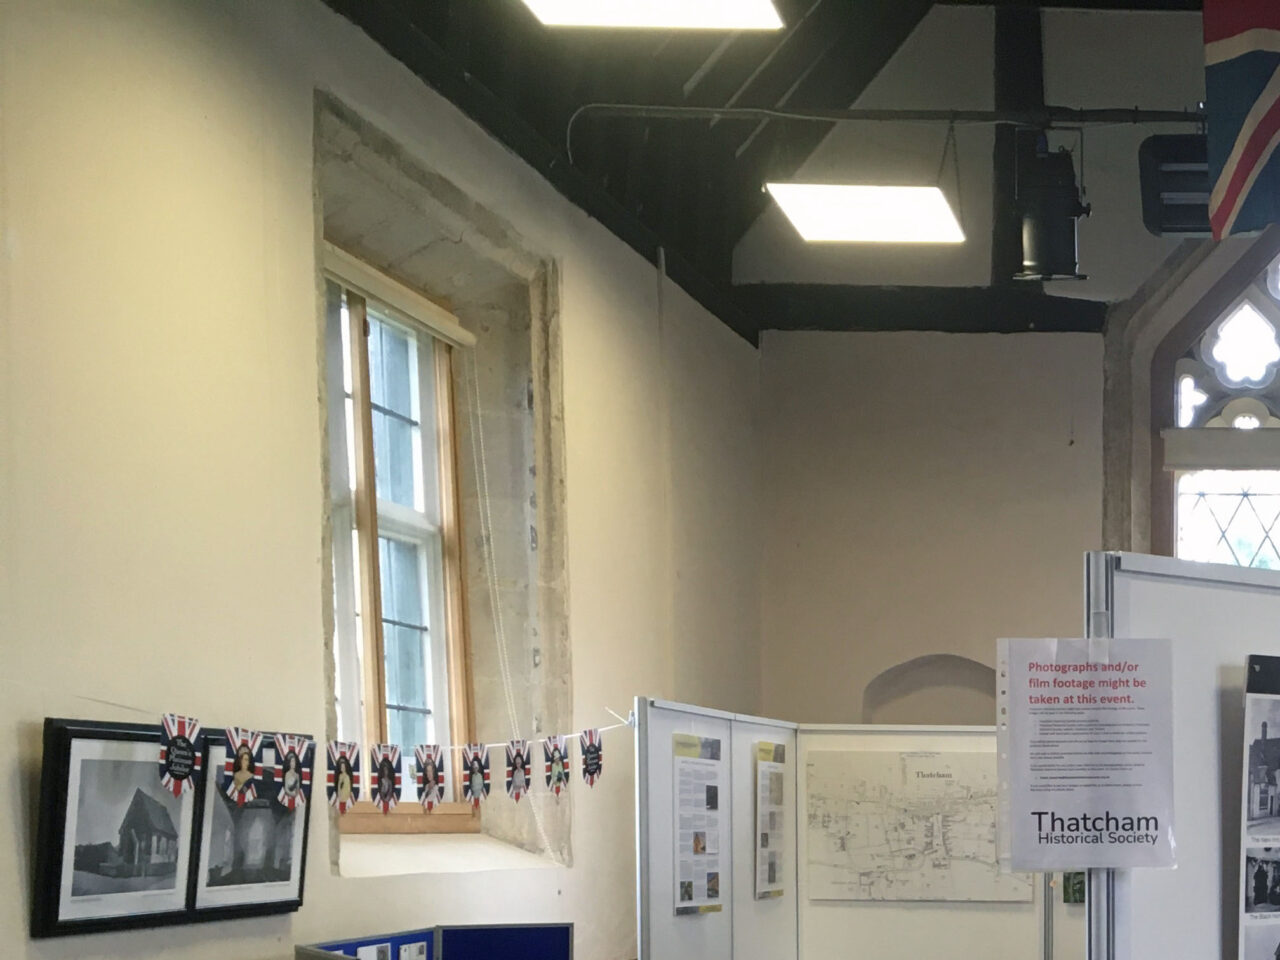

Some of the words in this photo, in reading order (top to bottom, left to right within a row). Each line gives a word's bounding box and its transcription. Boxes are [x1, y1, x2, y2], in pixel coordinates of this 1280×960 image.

[1028, 661, 1098, 675] Photographs
[1101, 661, 1139, 672] and/or
[1028, 678, 1050, 689] film
[1053, 678, 1095, 691] footage
[1098, 678, 1130, 691] might
[1132, 678, 1147, 688] be
[1028, 694, 1060, 704] taken
[1063, 695, 1074, 704] at
[1077, 694, 1097, 704] this
[1100, 694, 1135, 704] event.
[1030, 811, 1159, 832] Thatcham
[1038, 832, 1104, 844] Historical
[1108, 831, 1158, 845] Society
